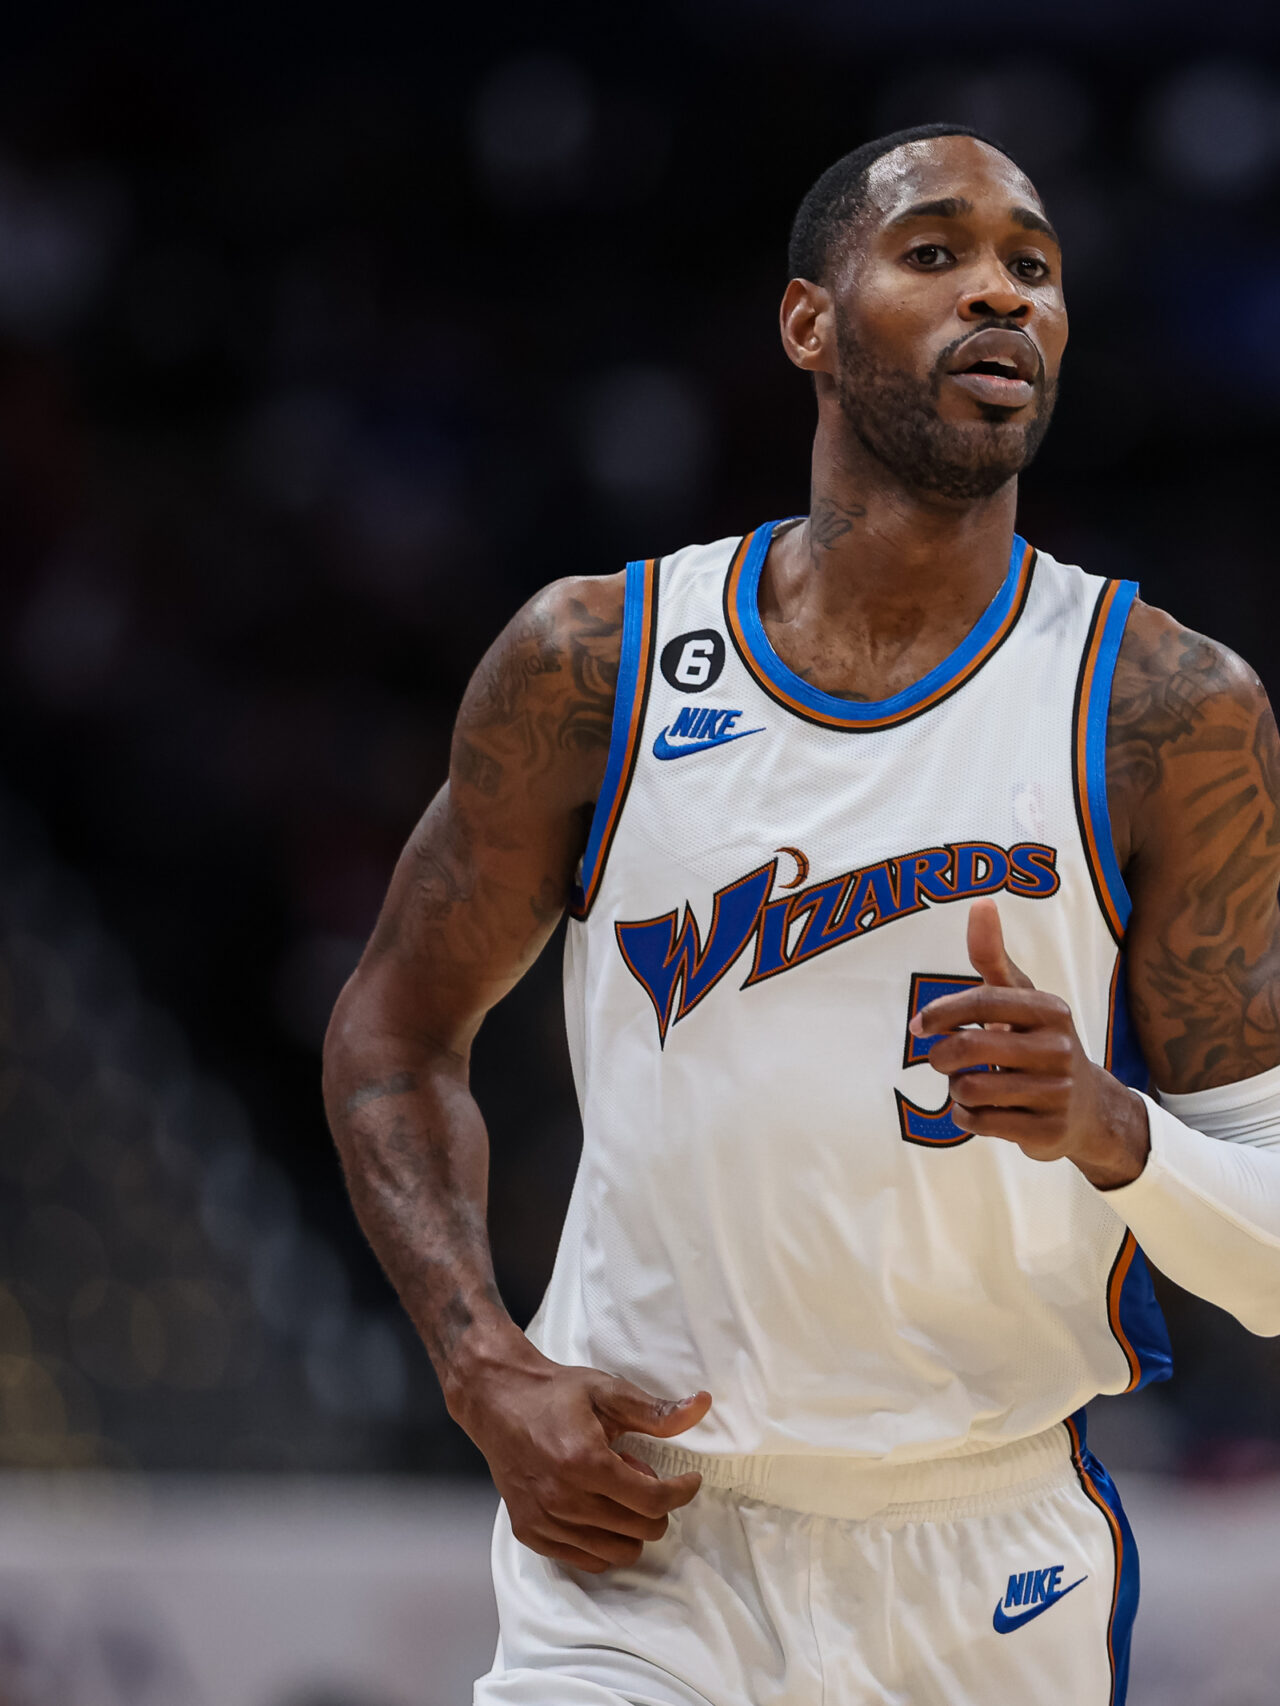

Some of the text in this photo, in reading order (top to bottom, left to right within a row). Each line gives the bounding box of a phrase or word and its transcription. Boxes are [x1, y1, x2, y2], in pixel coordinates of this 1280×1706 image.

[674, 638, 715, 686] 6
[668, 707, 743, 739] NIKE
[1004, 1564, 1065, 1608] NIKE
